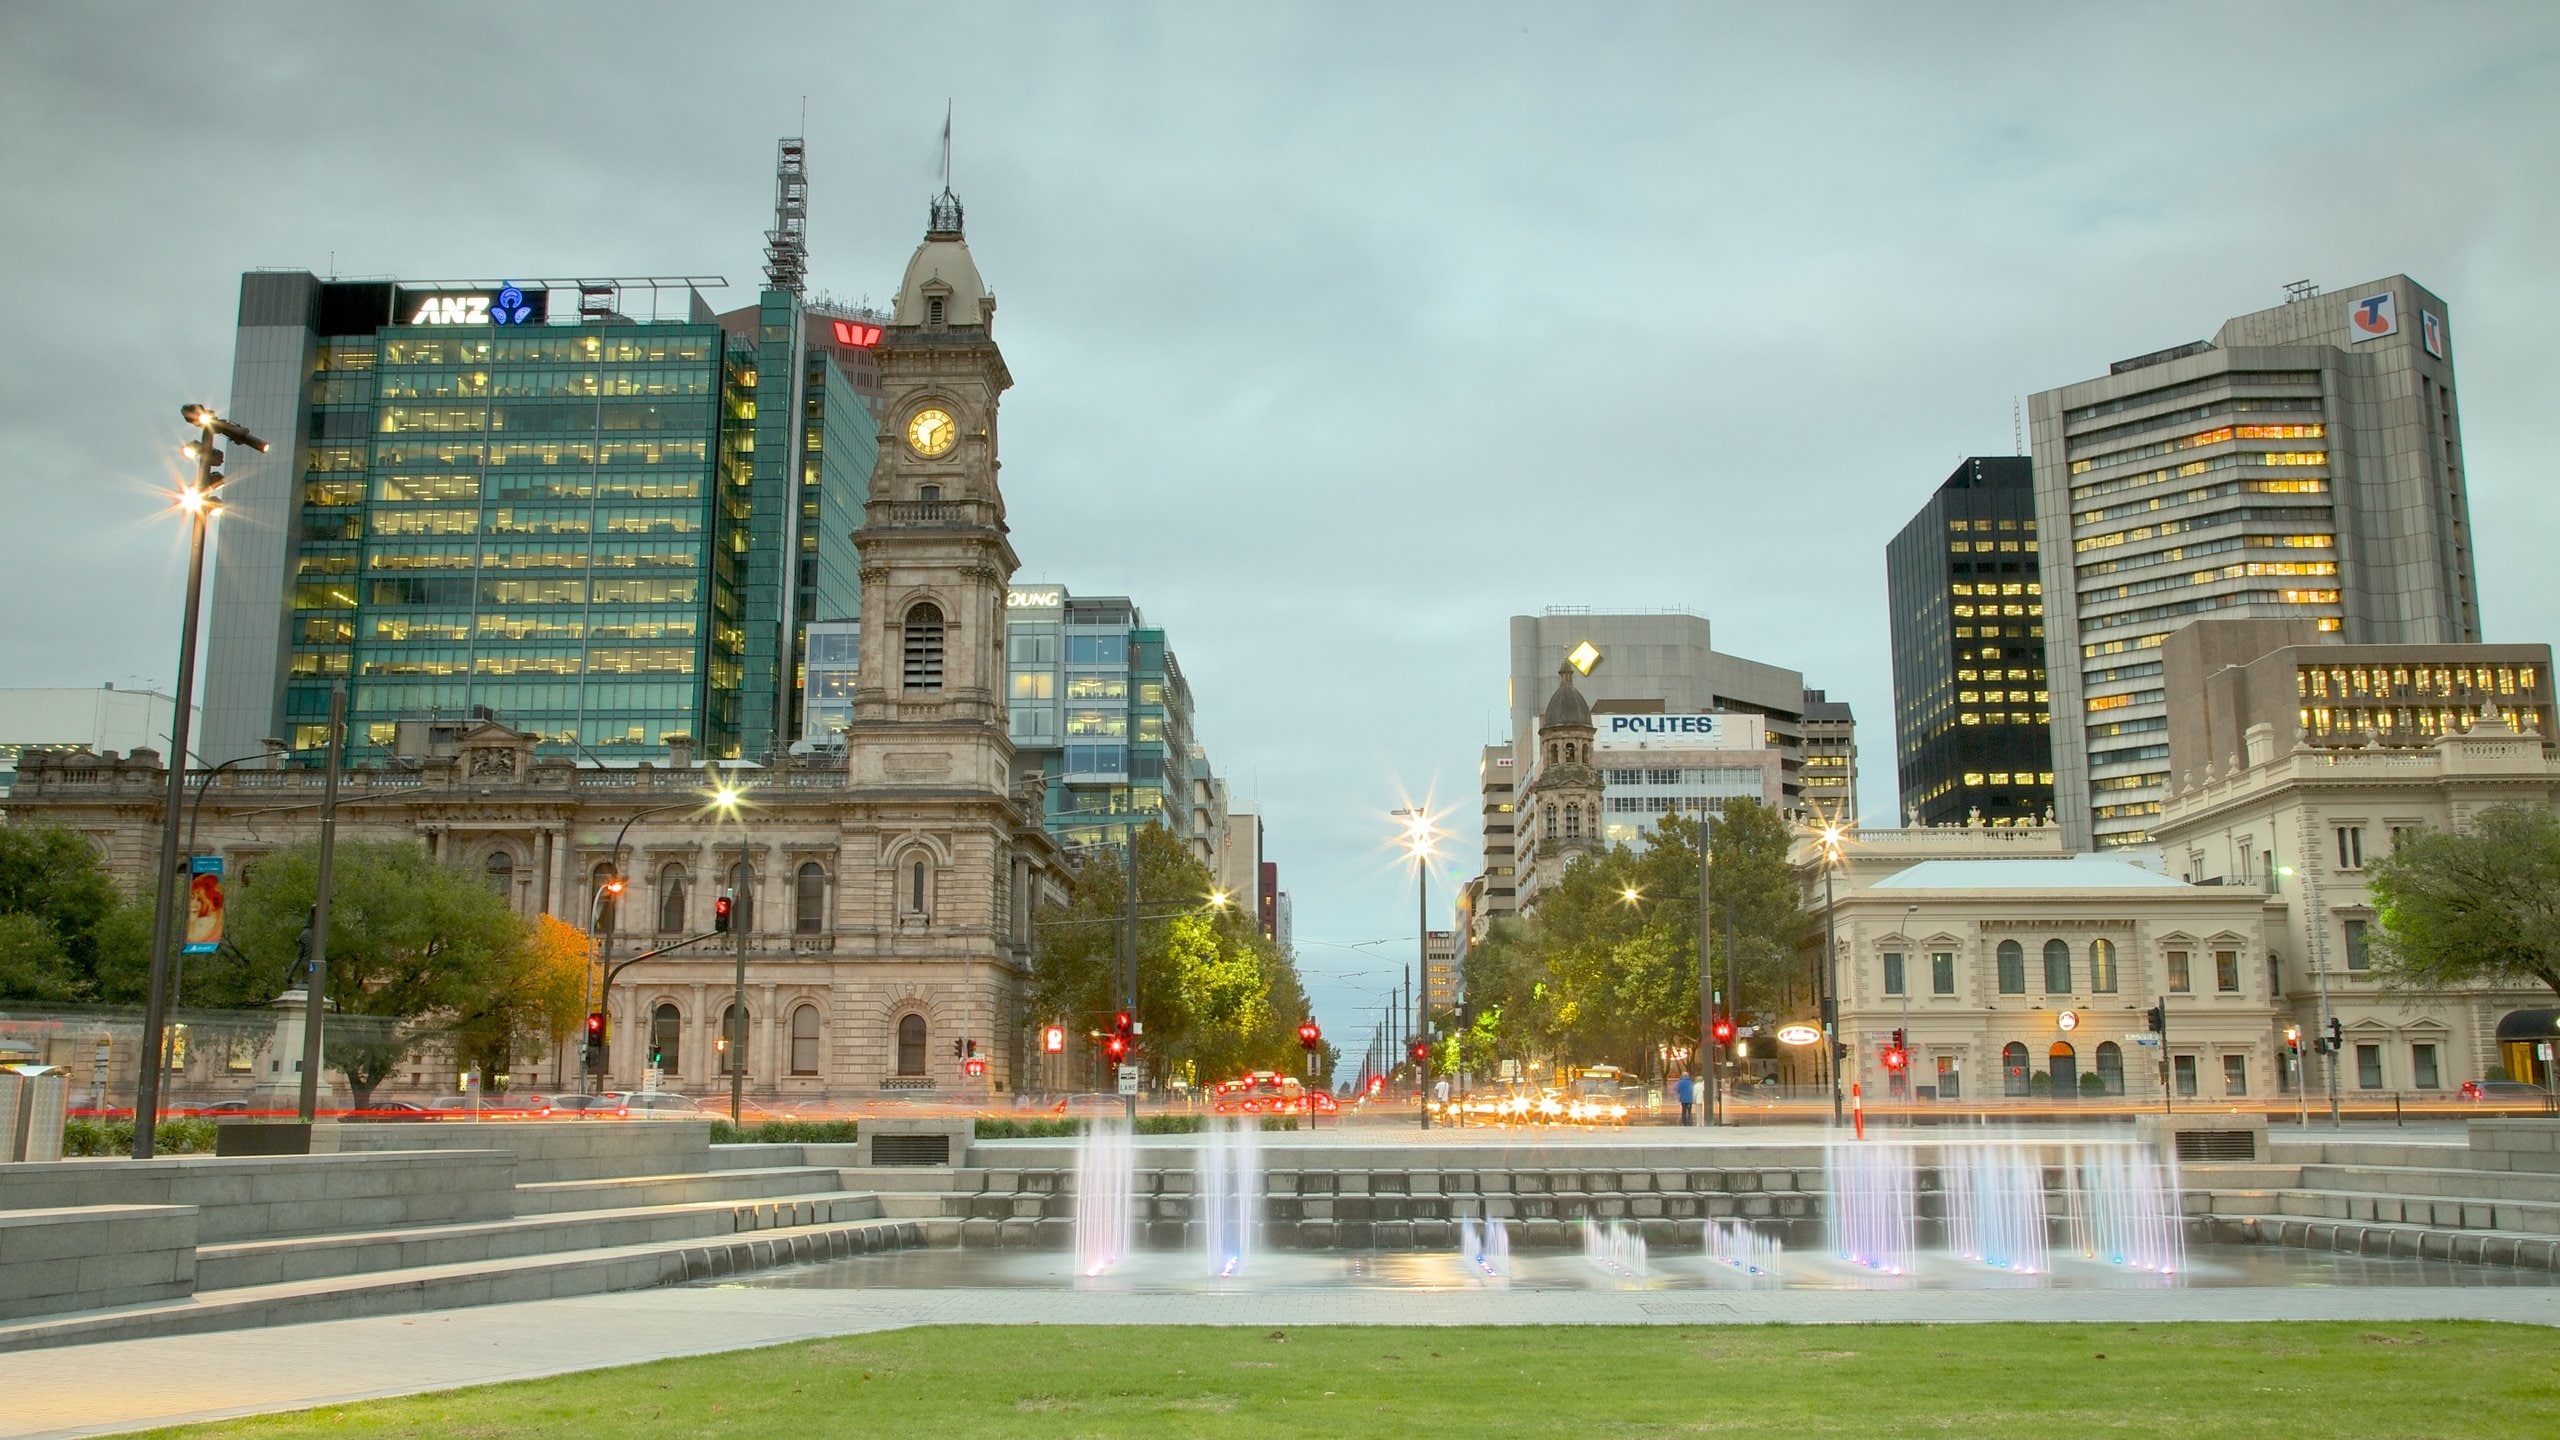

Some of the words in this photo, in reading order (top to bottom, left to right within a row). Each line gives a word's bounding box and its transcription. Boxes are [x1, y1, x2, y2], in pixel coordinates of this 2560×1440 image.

[411, 296, 490, 325] ANZ
[1007, 589, 1059, 607] OUNG
[1611, 716, 1713, 734] POLITES
